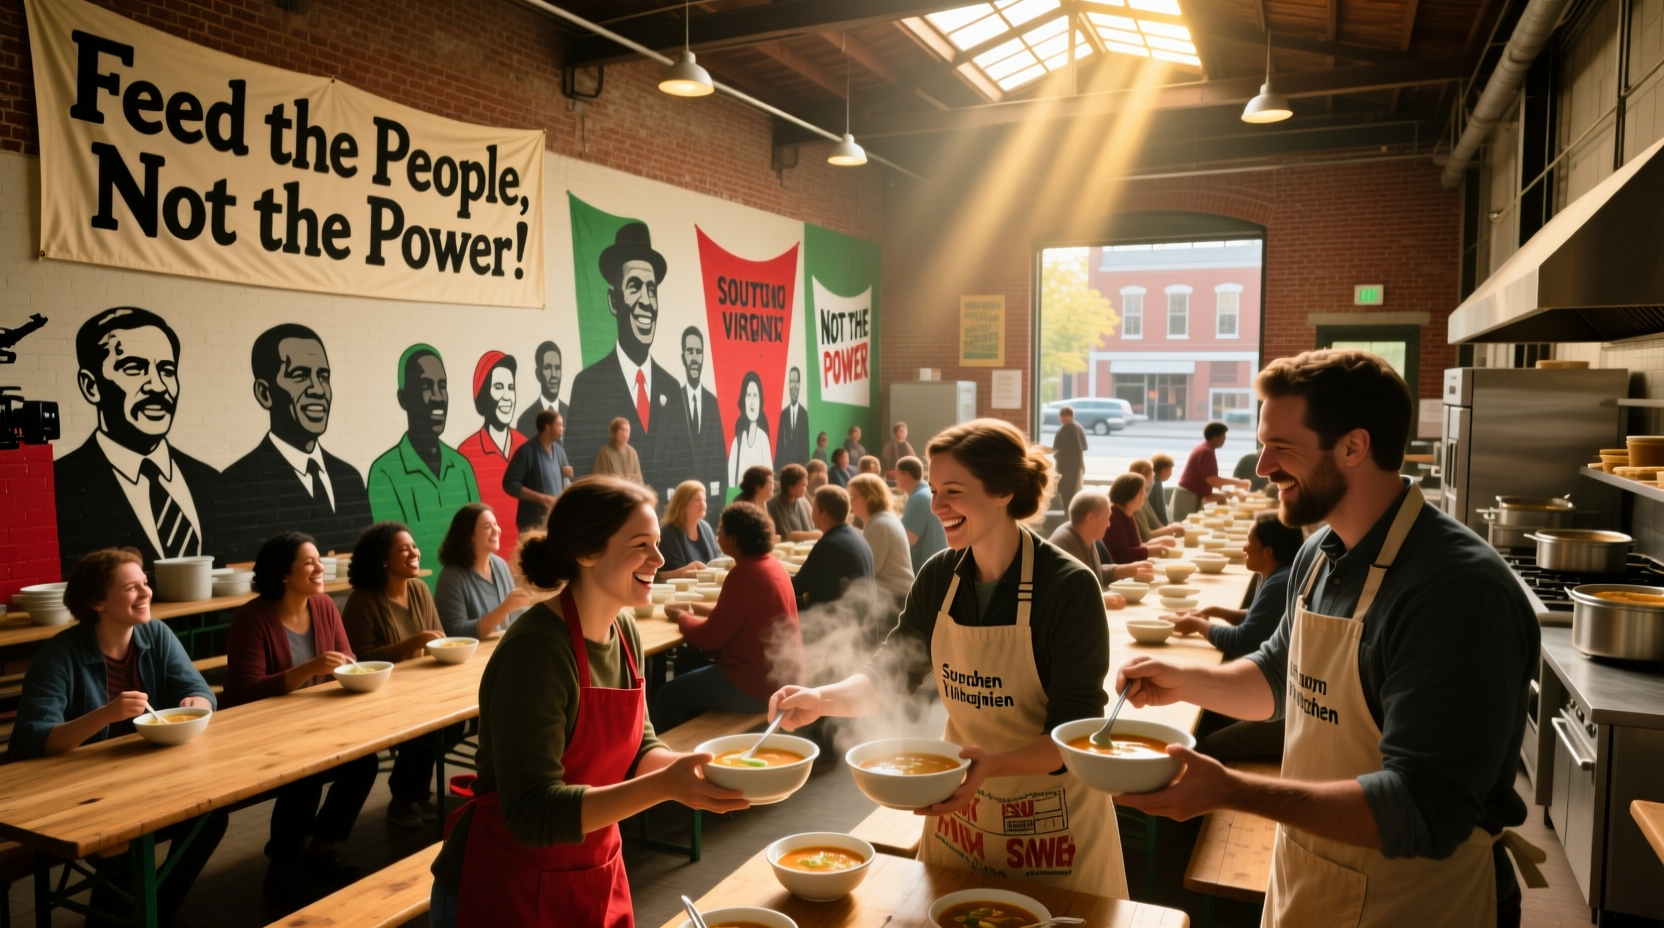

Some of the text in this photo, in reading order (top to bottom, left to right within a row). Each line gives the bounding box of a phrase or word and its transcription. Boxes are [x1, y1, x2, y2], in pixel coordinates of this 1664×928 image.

[70, 29, 530, 219] Feed the People,
[91, 141, 529, 280] Not the Power!
[820, 308, 869, 345] NOT THE
[823, 341, 868, 389] POWER
